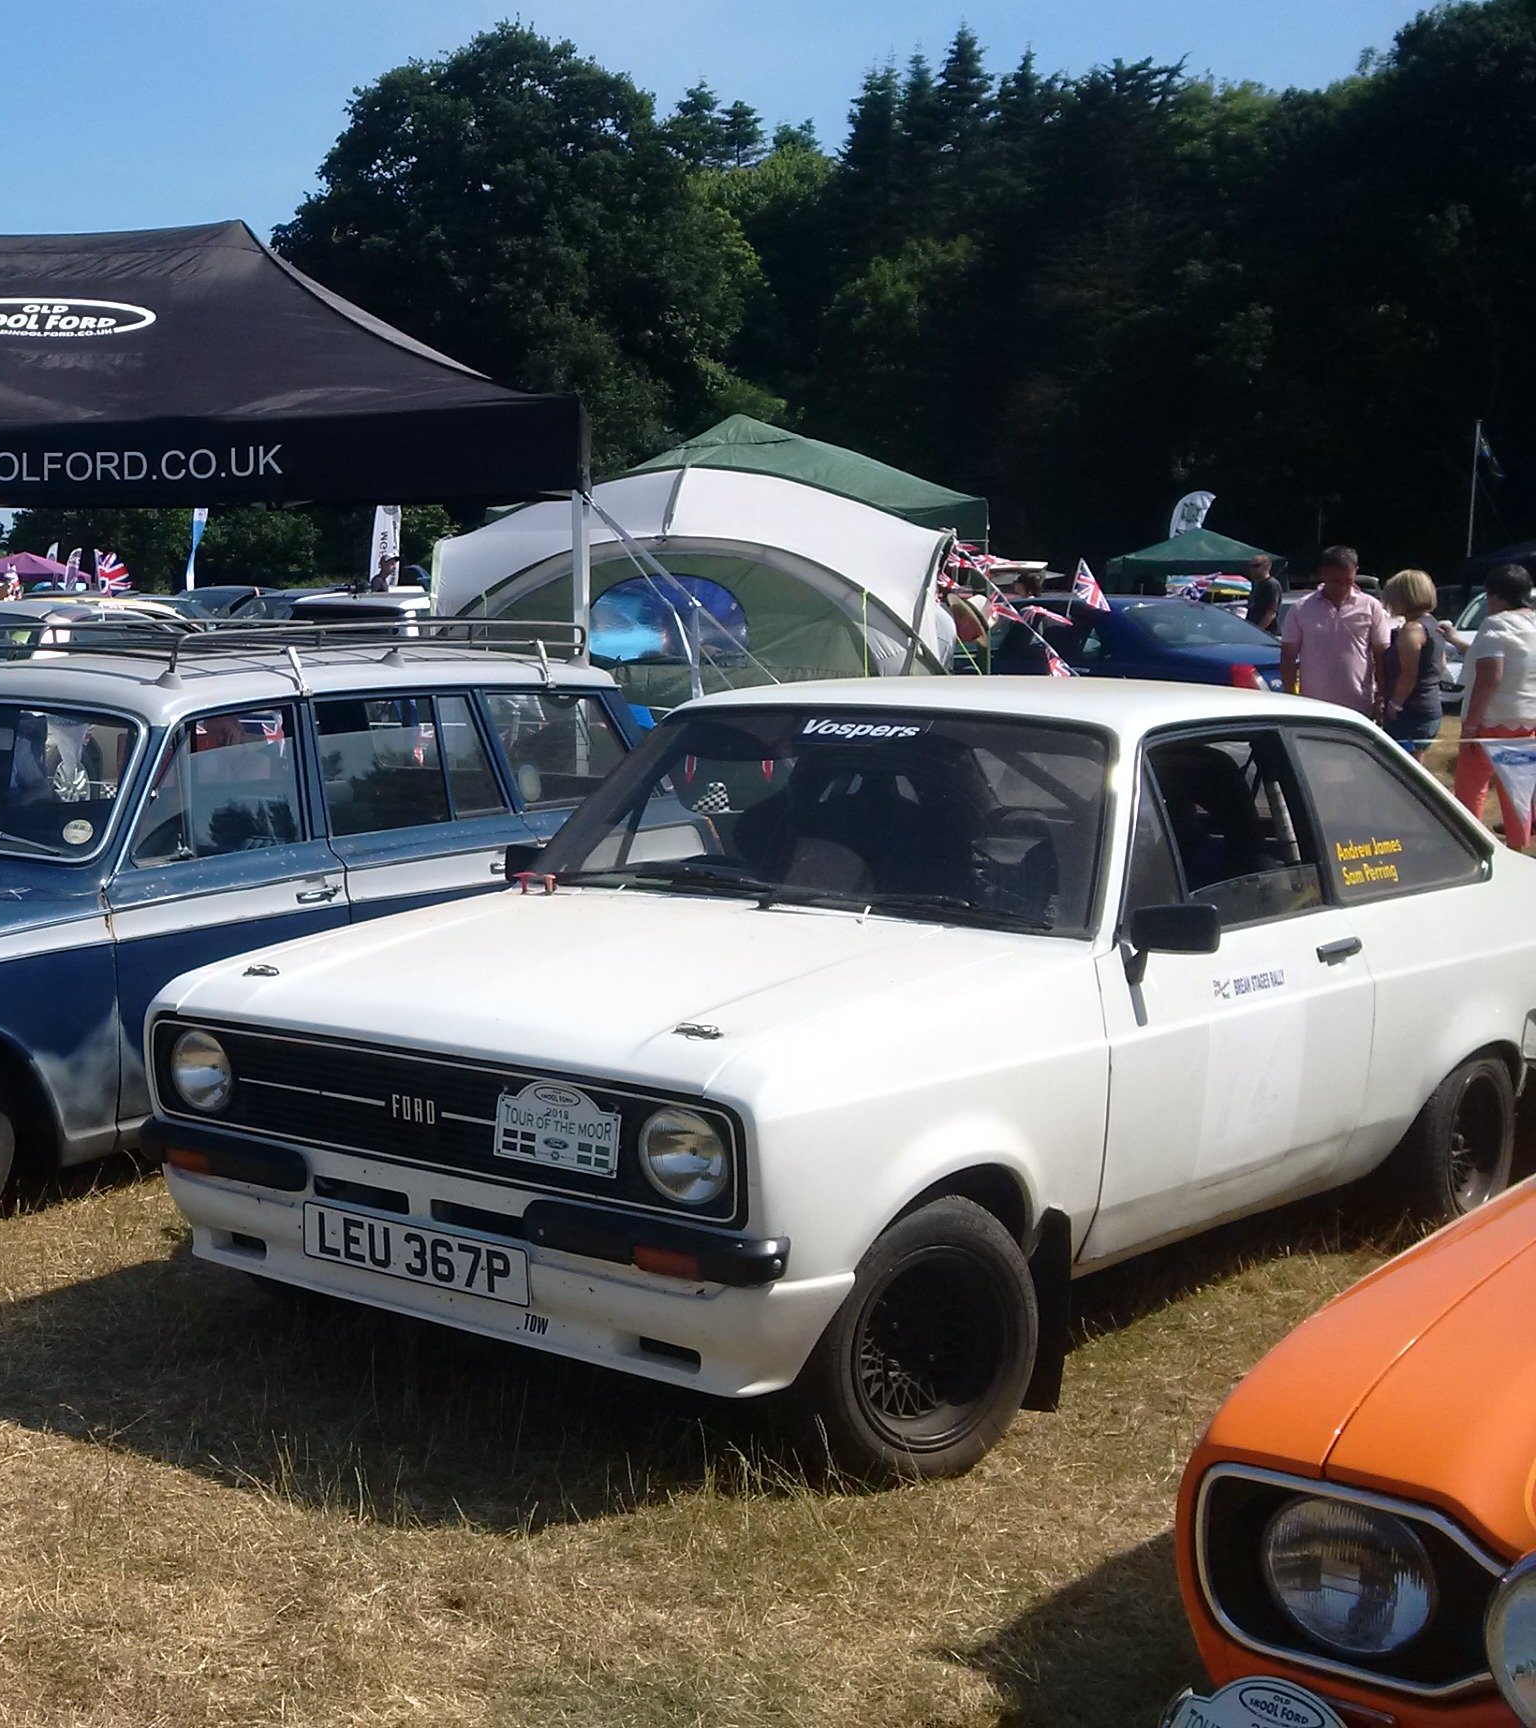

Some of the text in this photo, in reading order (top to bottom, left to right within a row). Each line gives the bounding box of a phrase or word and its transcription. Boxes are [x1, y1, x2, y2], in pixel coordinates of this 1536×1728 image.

[22, 304, 69, 314] OLD
[45, 315, 116, 330] FORD
[802, 719, 920, 739] Vospers
[1336, 837, 1402, 861] Andrew James
[1343, 860, 1399, 885] Sam Perring
[392, 1094, 436, 1125] FORD
[544, 1107, 570, 1120] 2018
[504, 1104, 612, 1141] TOUR OF THE MOOR
[318, 1211, 510, 1293] LEU 367P
[524, 1312, 549, 1336] TOW
[1249, 1697, 1279, 1719] SKOOL
[1280, 1706, 1310, 1725] FORD
[1273, 1694, 1291, 1705] OLD
